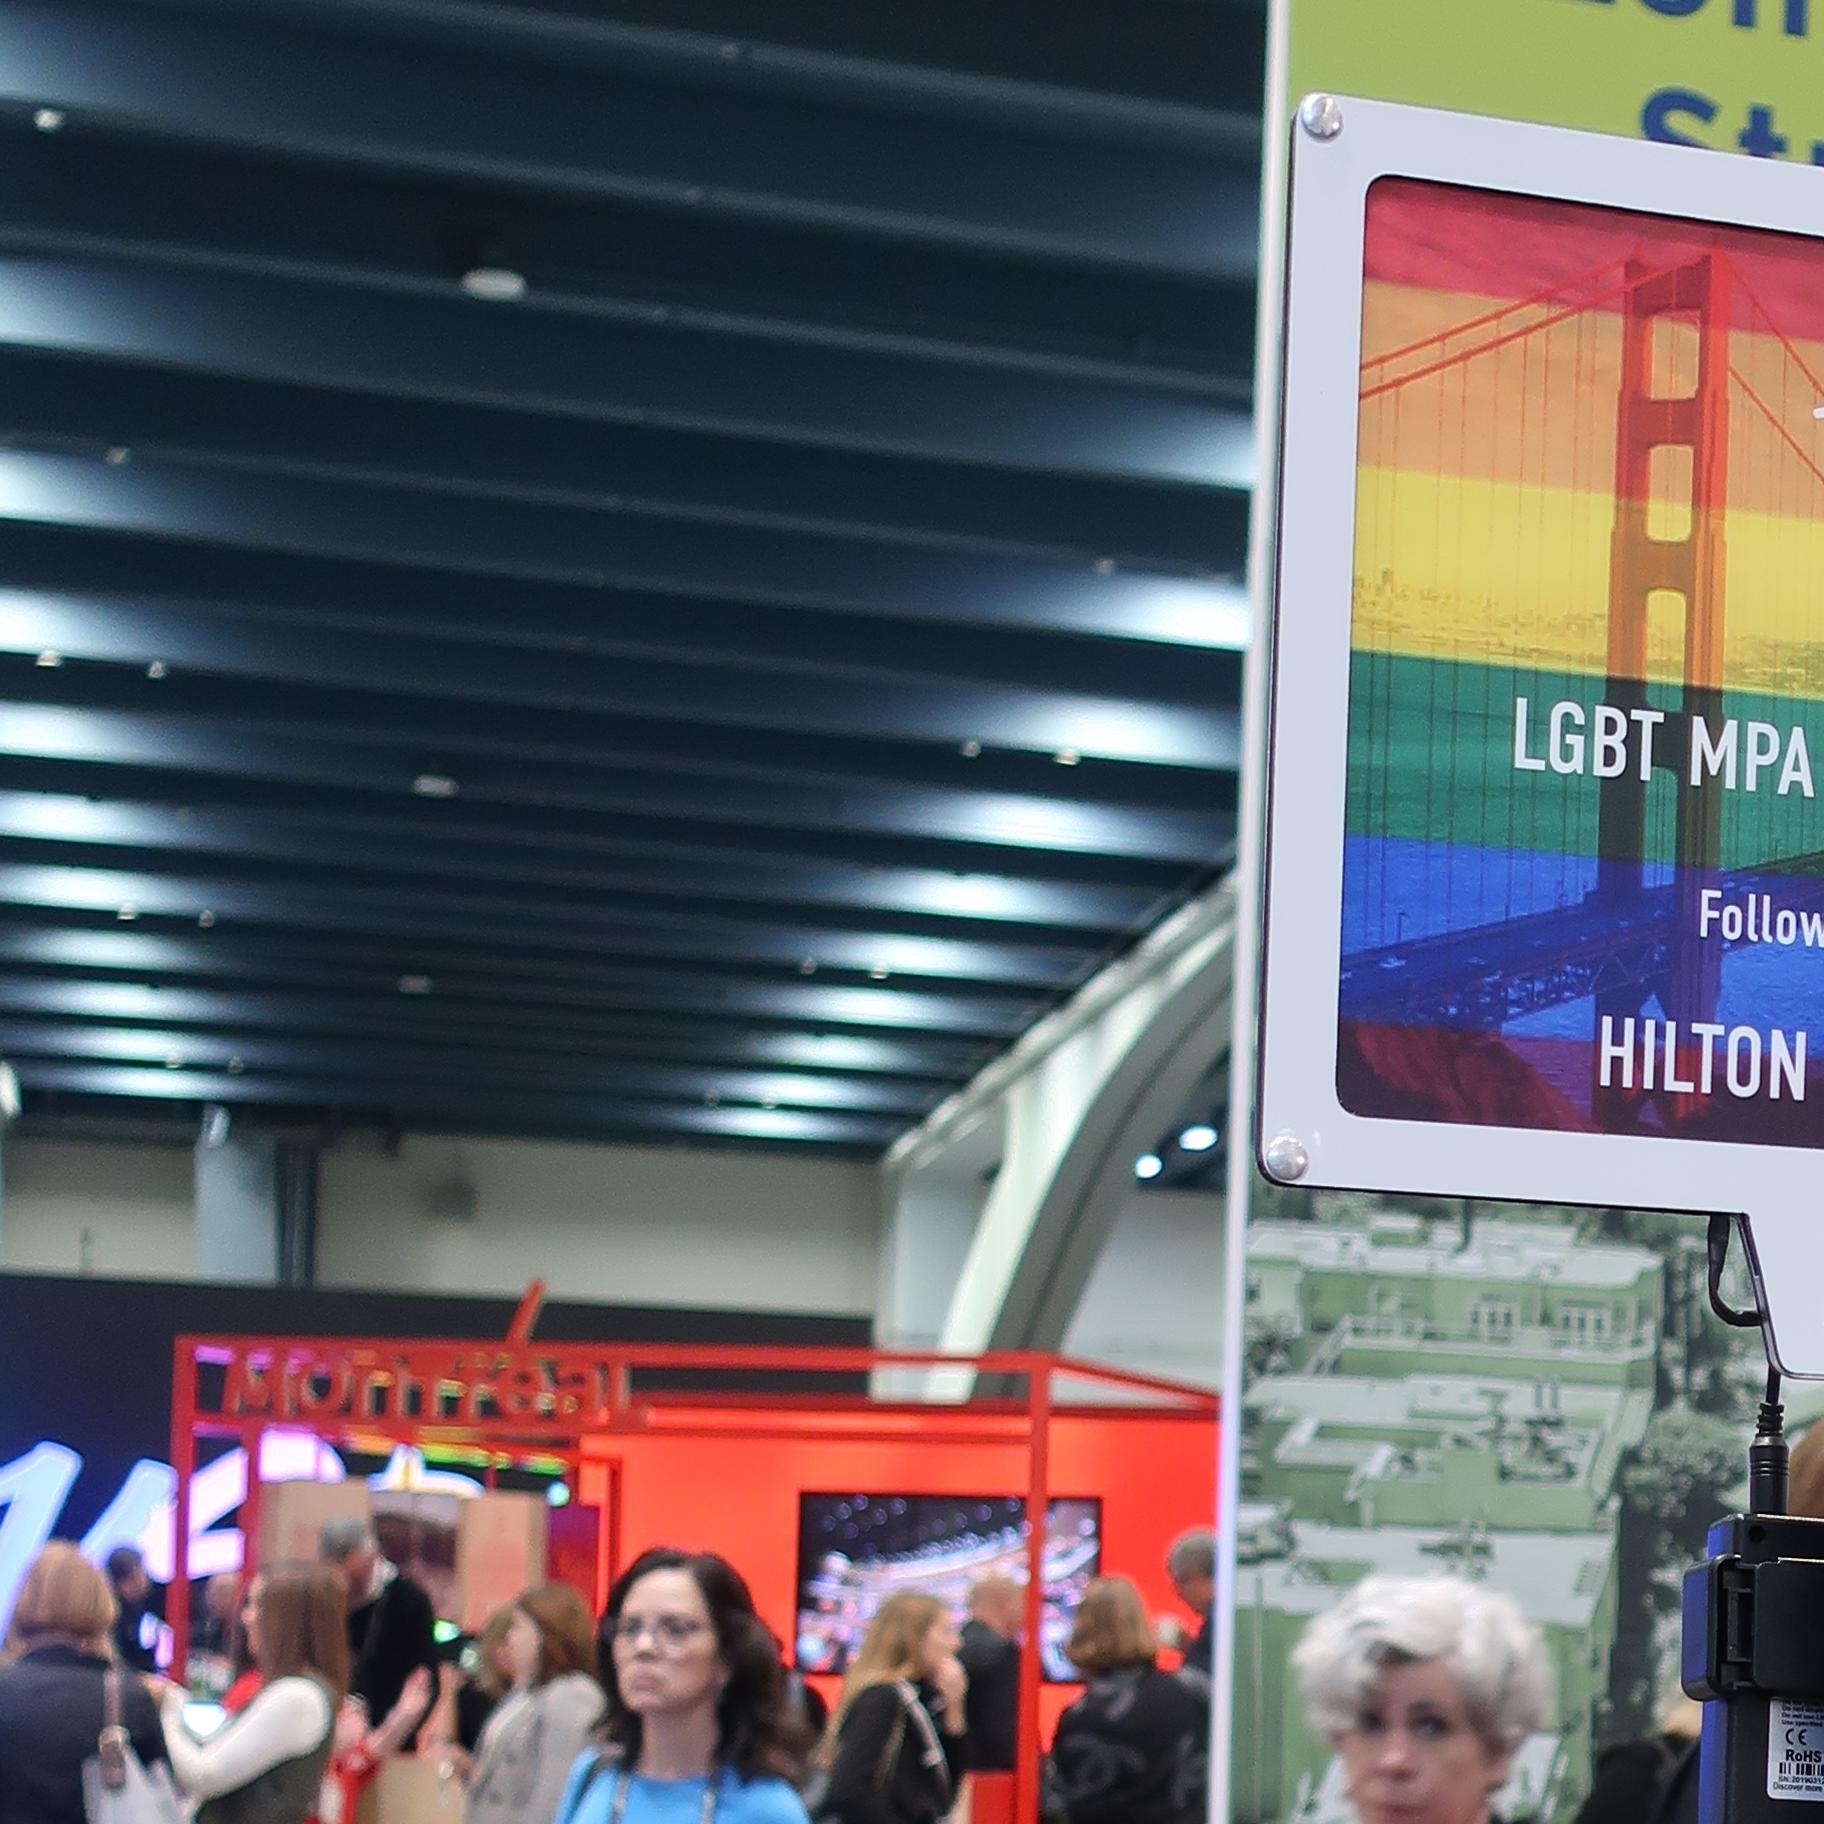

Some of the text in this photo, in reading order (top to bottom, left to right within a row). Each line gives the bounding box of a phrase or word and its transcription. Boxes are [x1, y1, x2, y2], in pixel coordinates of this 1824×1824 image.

[1514, 696, 1665, 781] LGBT
[1690, 715, 1815, 798] MPA
[1600, 1015, 1807, 1101] HILTON
[1785, 1749, 1822, 1763] RoHS
[1773, 1782, 1804, 1791] Discover
[1805, 1784, 1823, 1793] more
